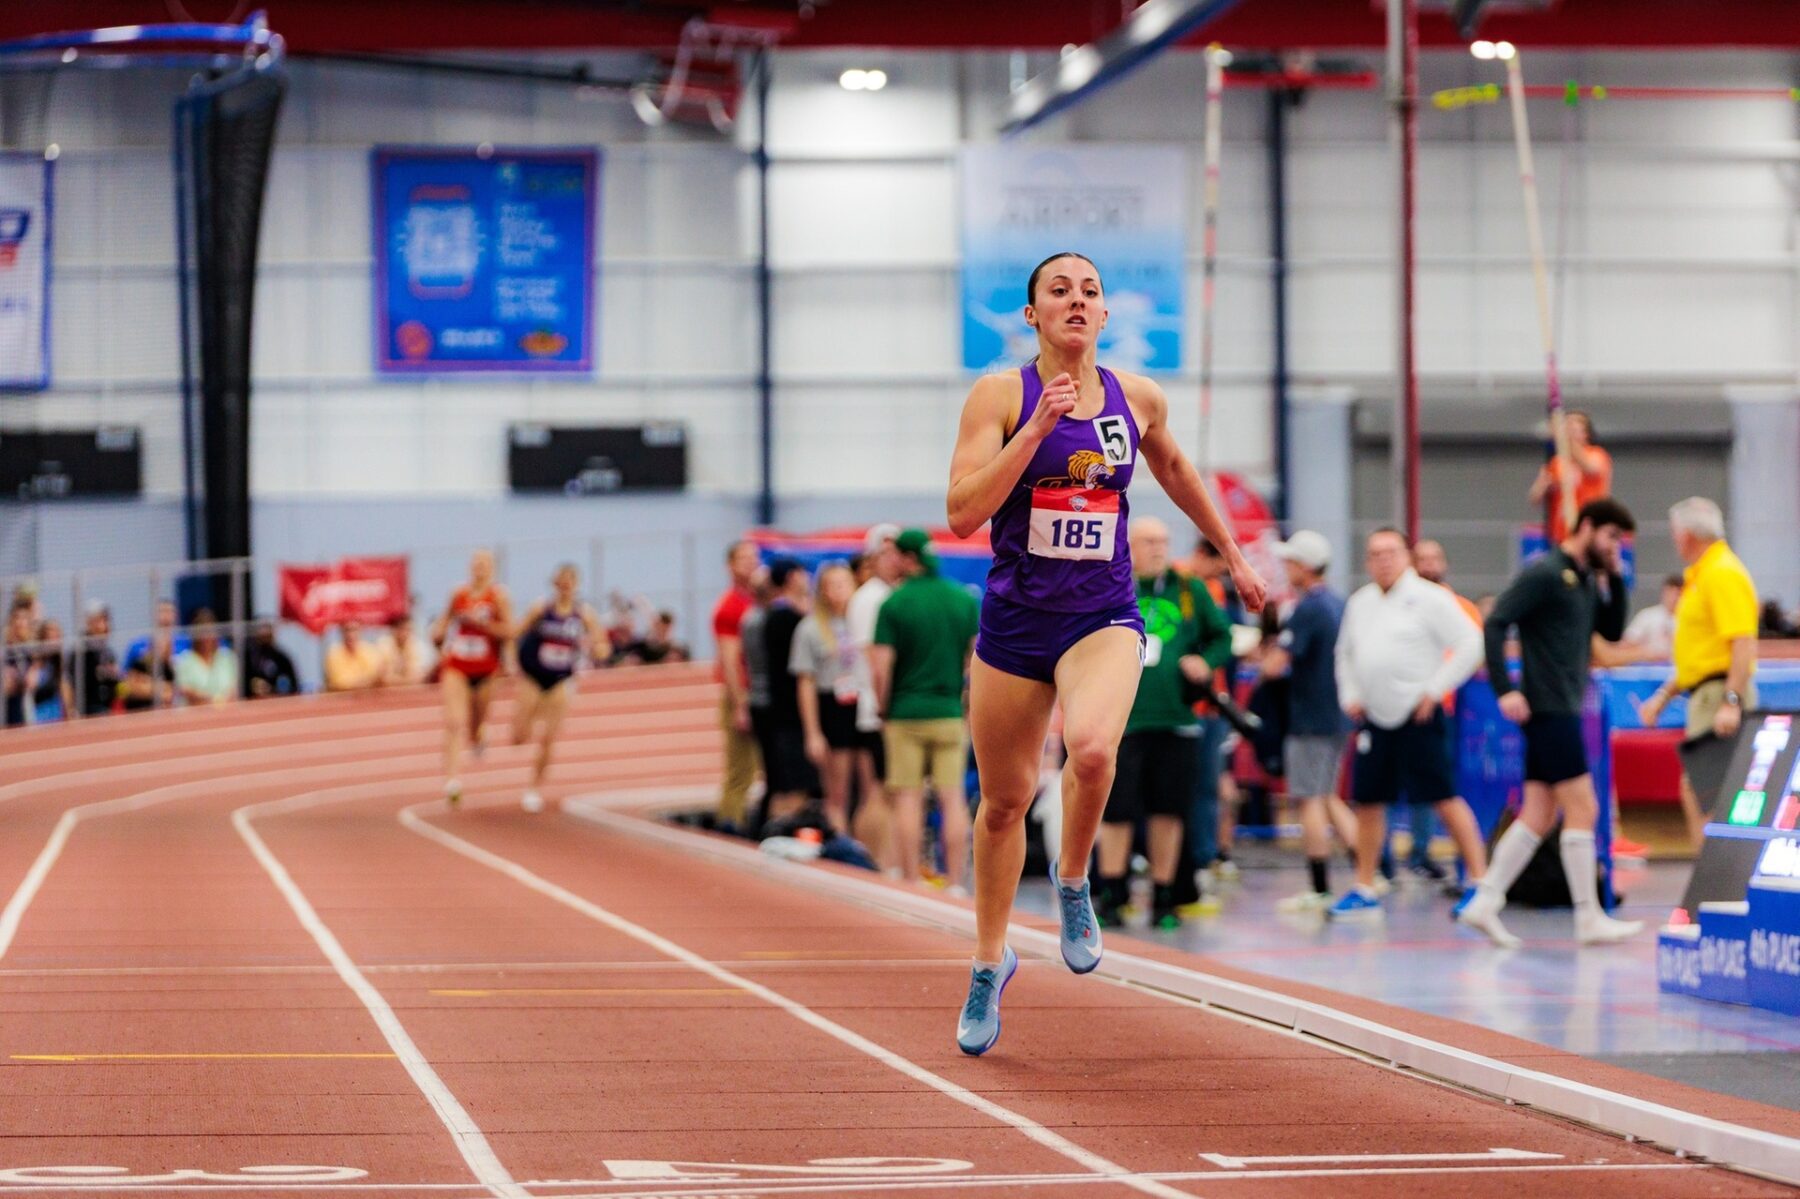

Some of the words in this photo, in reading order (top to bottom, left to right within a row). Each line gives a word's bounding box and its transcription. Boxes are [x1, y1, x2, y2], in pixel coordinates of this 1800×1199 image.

[1099, 419, 1127, 461] 5
[1051, 518, 1103, 550] 185
[0, 1164, 368, 1185] 3
[602, 1156, 974, 1178] 2
